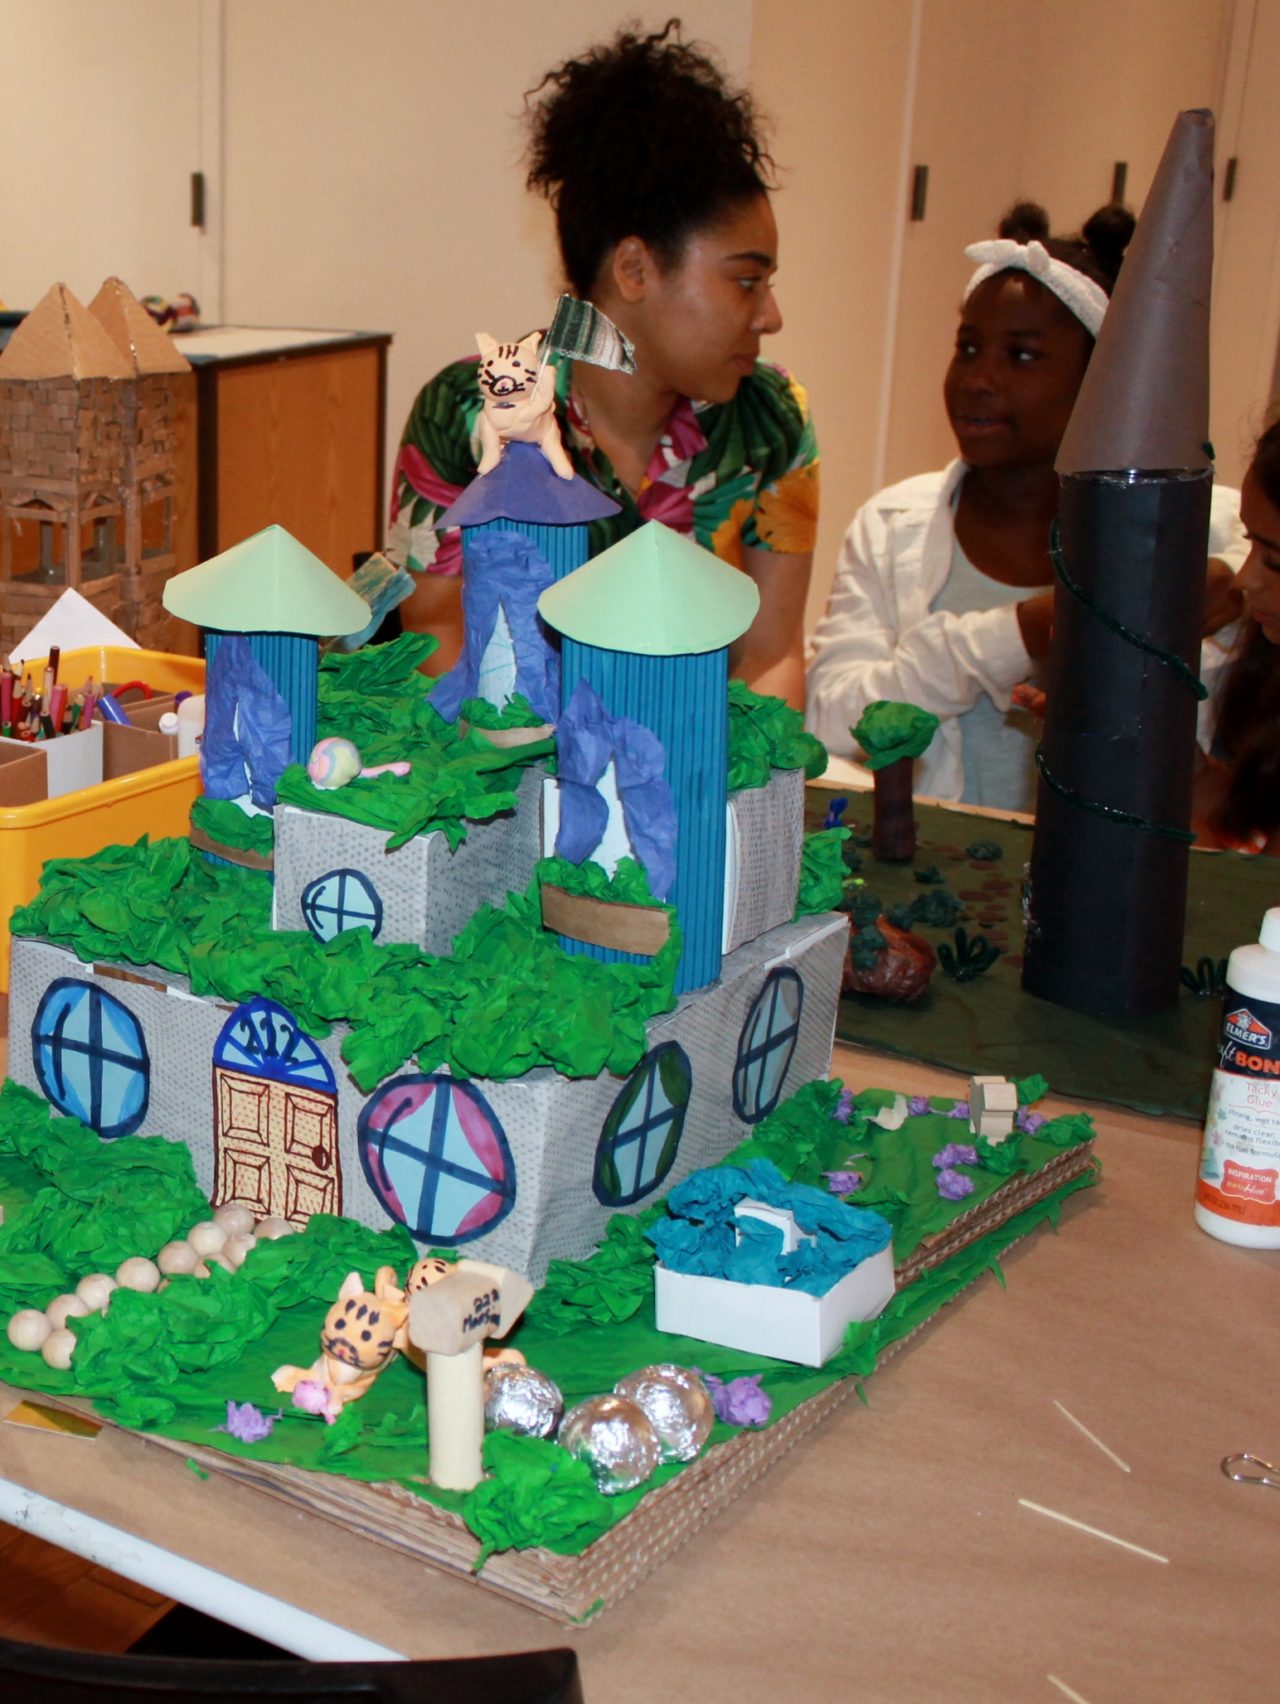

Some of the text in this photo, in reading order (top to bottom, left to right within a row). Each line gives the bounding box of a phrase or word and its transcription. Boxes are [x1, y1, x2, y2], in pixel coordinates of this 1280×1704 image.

[1225, 1023, 1268, 1046] ELMER'S
[1246, 1094, 1273, 1108] Glue
[1227, 1168, 1272, 1184] INSPIRATION
